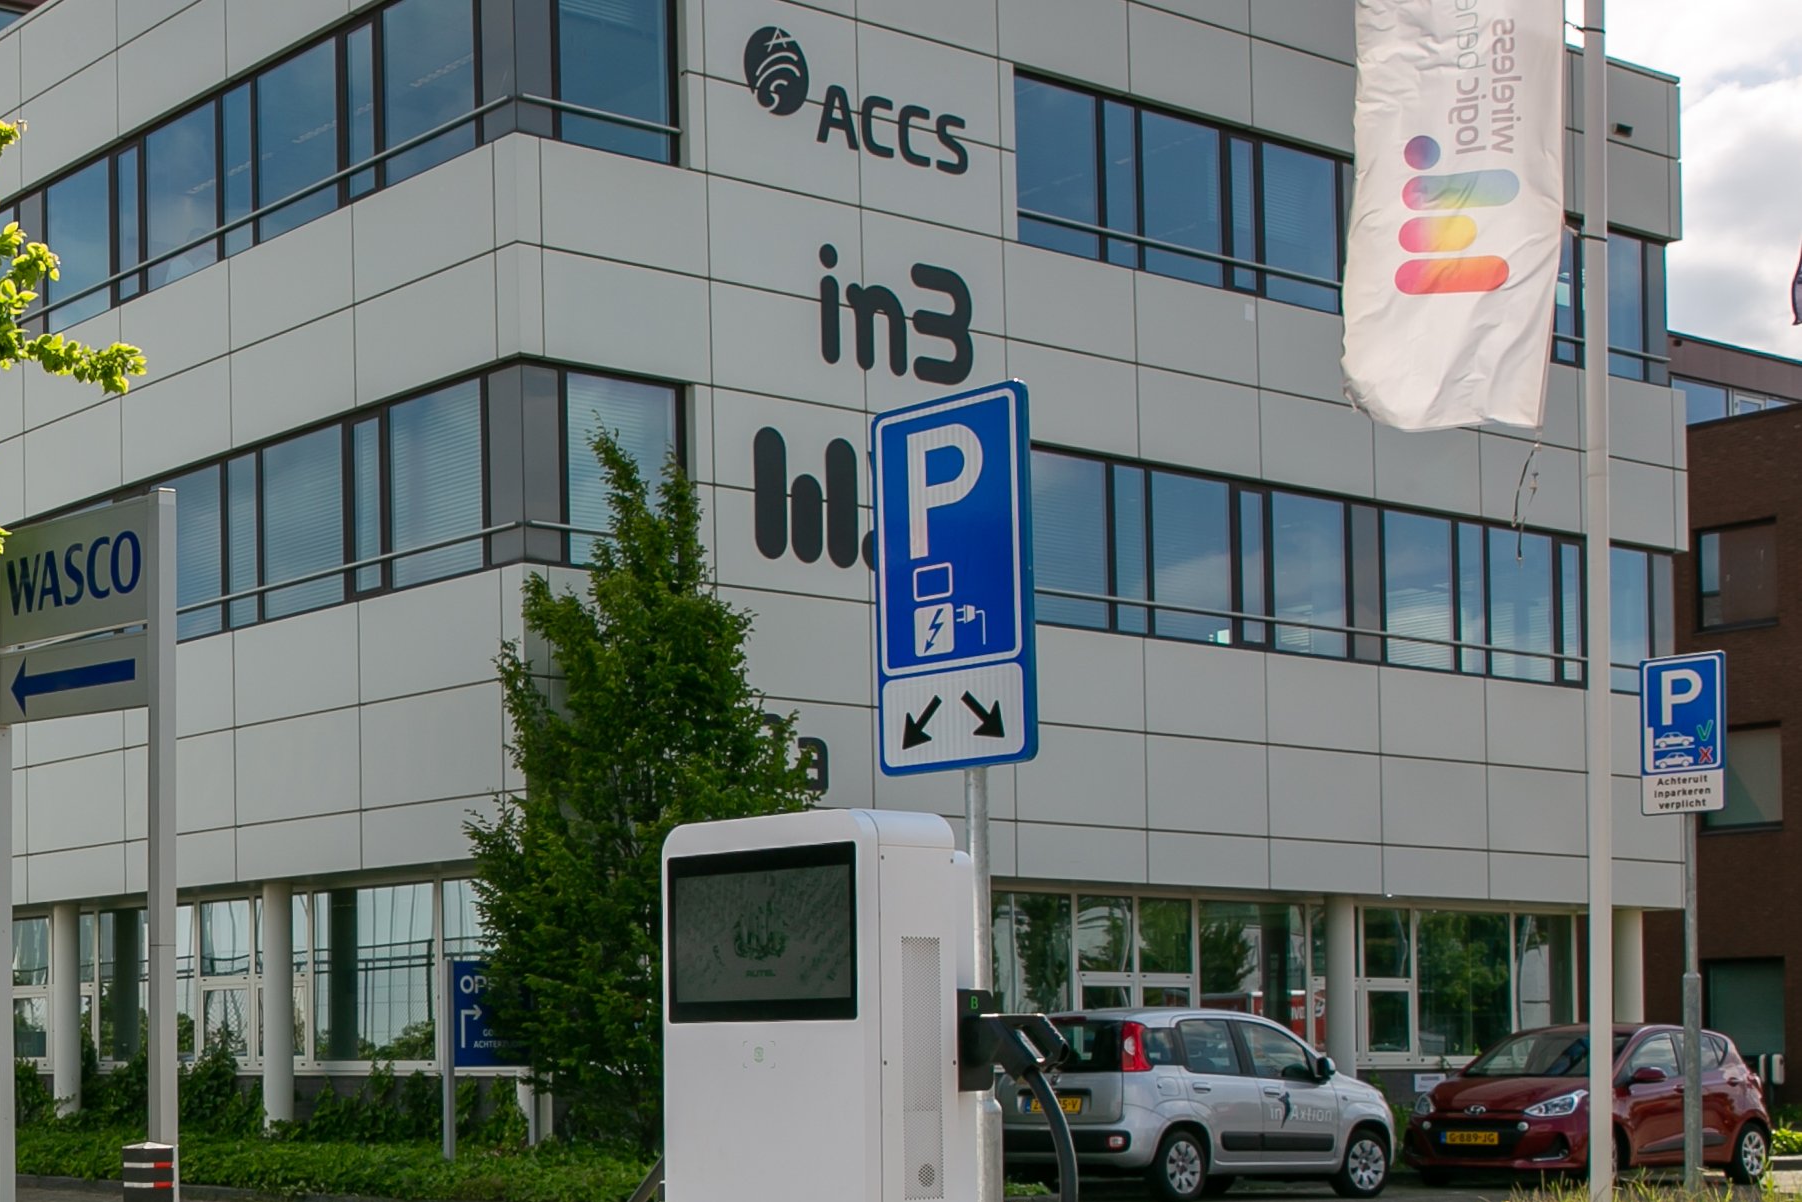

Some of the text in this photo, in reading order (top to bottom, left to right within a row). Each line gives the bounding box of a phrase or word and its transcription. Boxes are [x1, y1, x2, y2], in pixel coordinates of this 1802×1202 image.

[816, 84, 969, 175] ACCS
[819, 243, 974, 386] in3
[906, 422, 984, 561] P
[6, 530, 142, 616] WASCO
[1660, 668, 1703, 726] P
[1657, 775, 1709, 786] Achteruit
[1659, 799, 1708, 810] verplicht
[970, 996, 979, 1010] B
